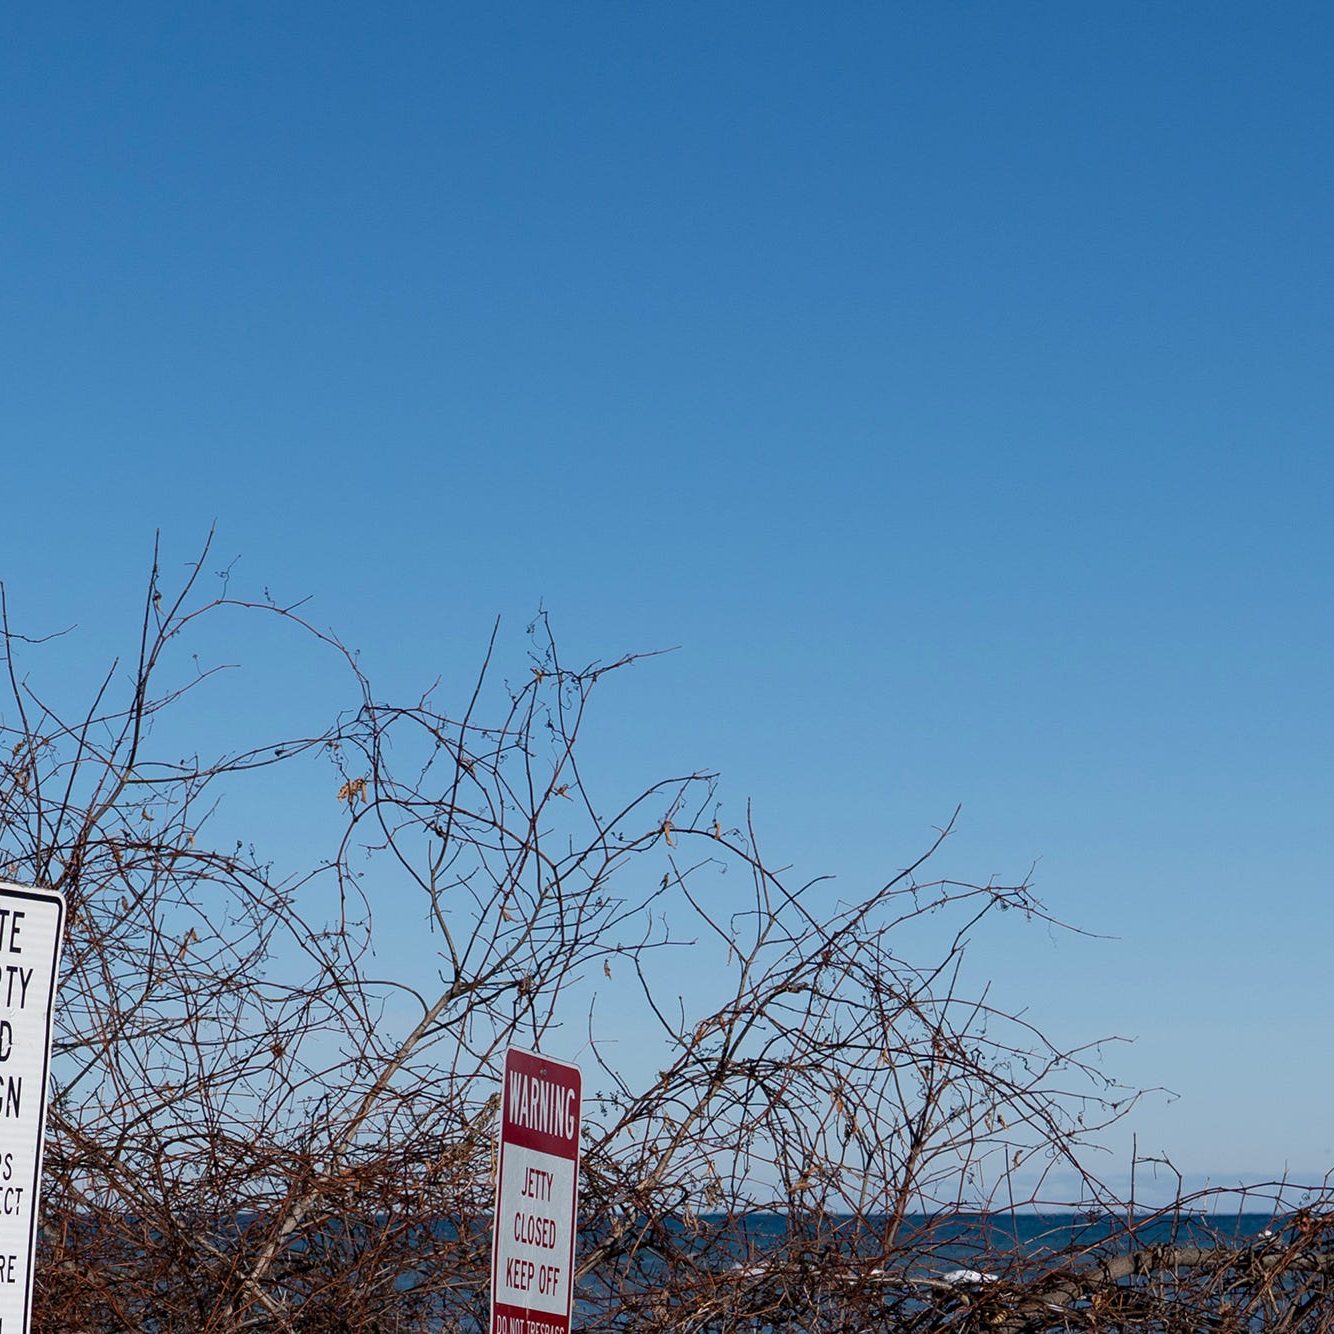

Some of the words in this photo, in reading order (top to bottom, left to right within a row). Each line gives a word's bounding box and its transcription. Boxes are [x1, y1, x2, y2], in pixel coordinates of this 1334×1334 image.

[509, 1070, 575, 1140] WARNING
[521, 1167, 554, 1202] JETTY
[514, 1211, 557, 1249] CLOSED
[505, 1257, 535, 1291] KEEP
[539, 1264, 560, 1296] OFF
